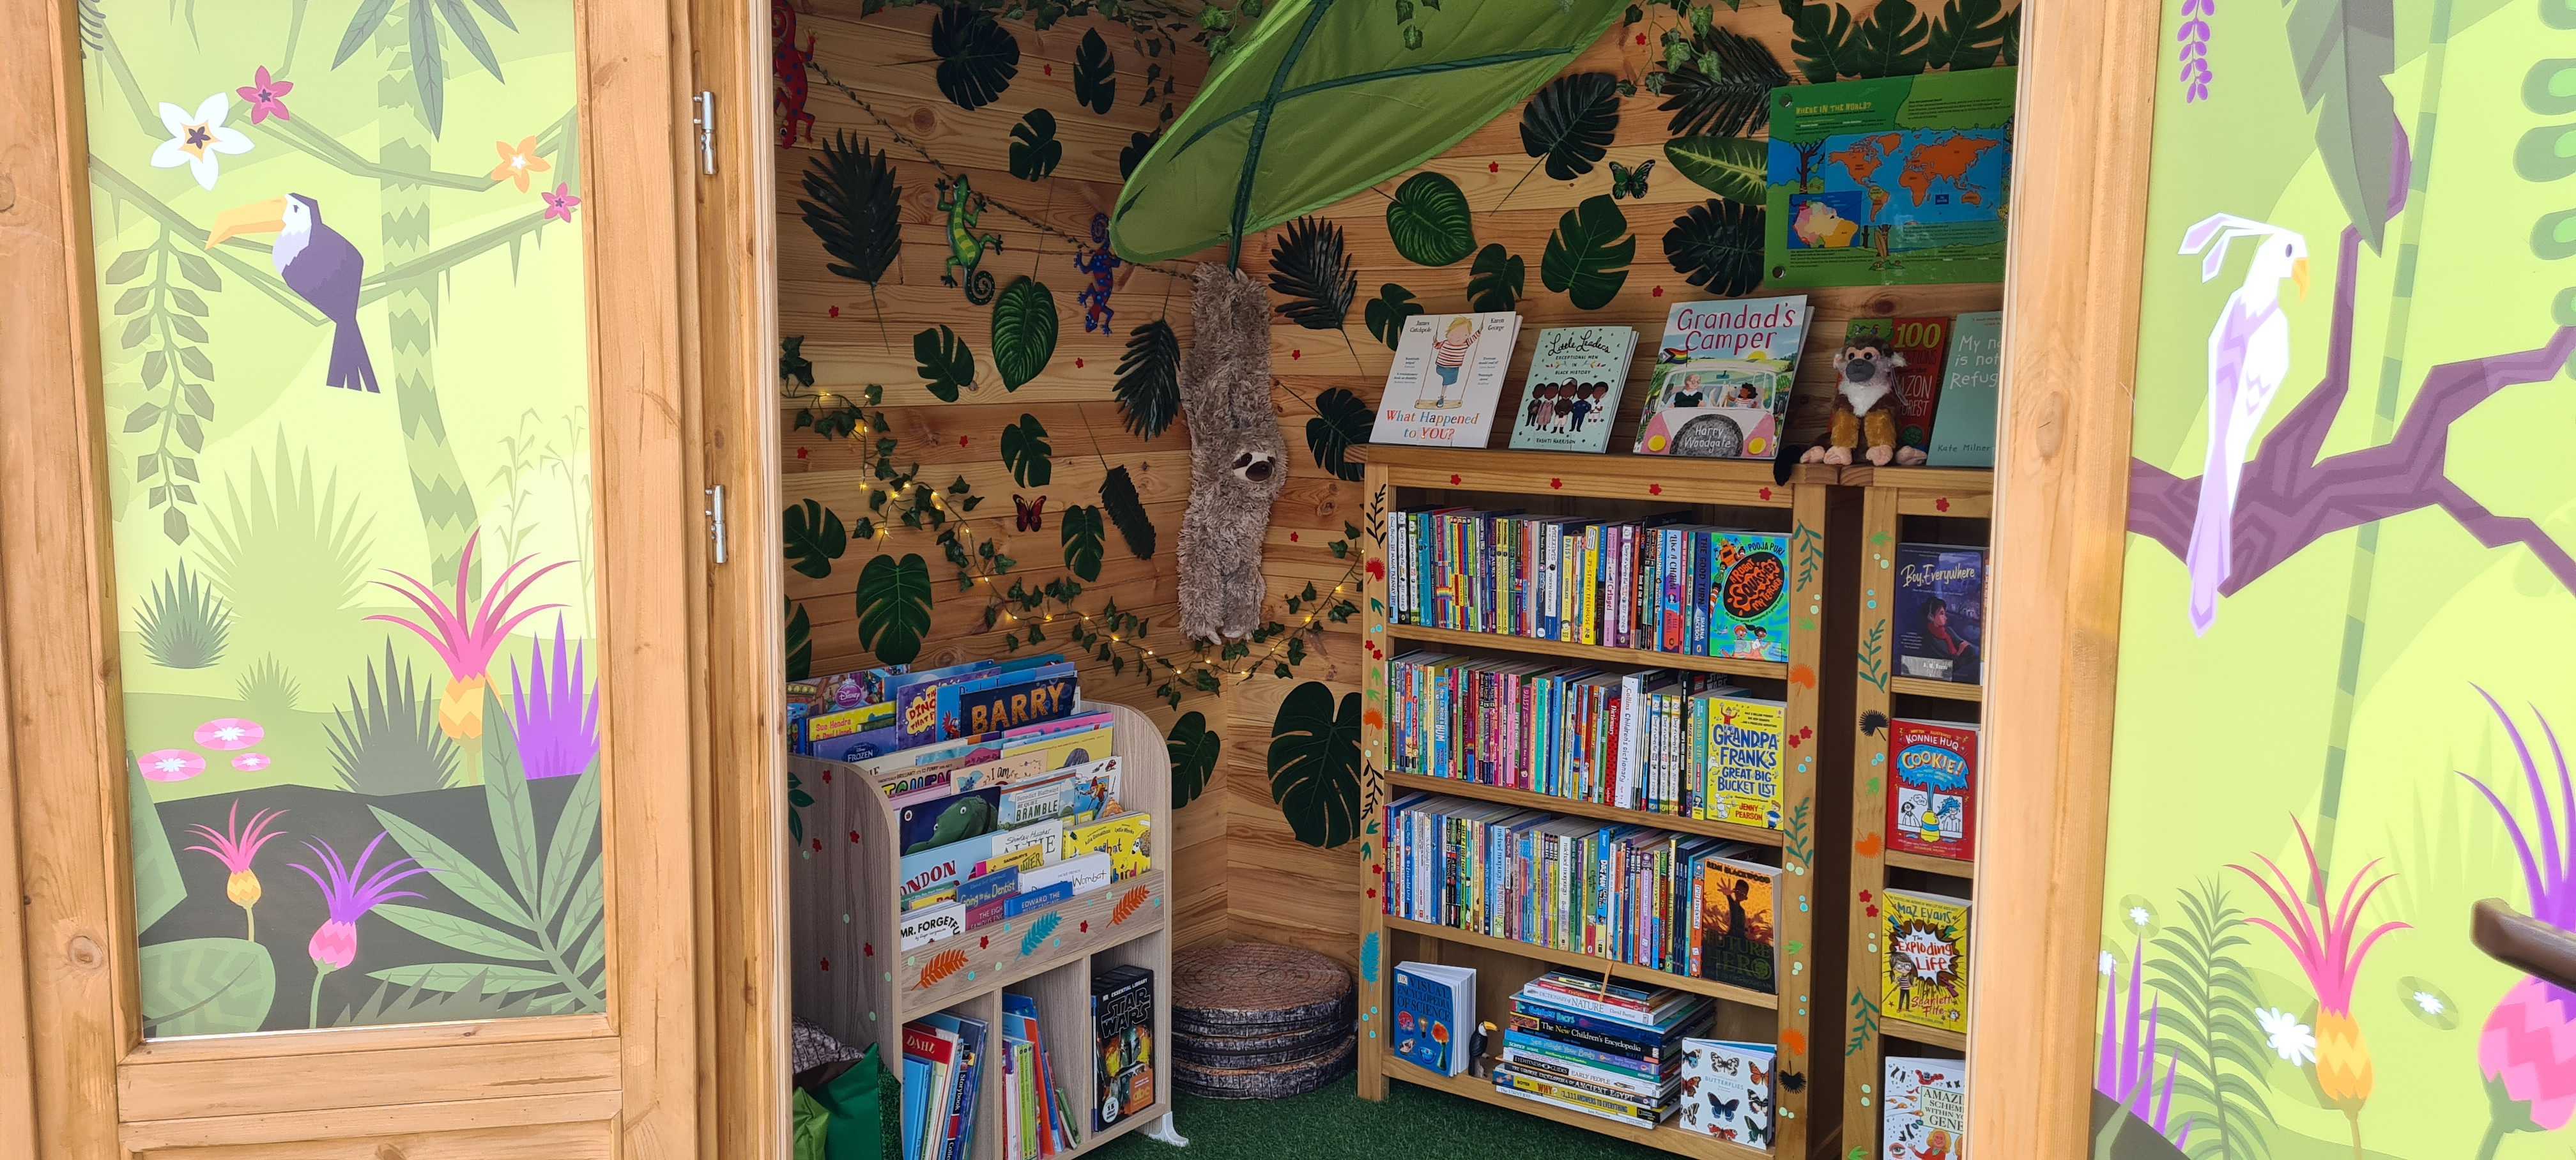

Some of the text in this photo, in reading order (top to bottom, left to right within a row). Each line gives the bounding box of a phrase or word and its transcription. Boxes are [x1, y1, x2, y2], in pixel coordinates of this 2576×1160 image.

[1796, 107, 1818, 115] WHERE
[1820, 105, 1828, 113] IN
[1846, 102, 1871, 111] WORLD?
[1677, 303, 1796, 331] Grandad's
[1548, 330, 1610, 356] Little Leaders
[1685, 330, 1777, 356] Camper
[1894, 323, 1941, 348] 100
[1959, 335, 1980, 351] My
[1955, 355, 1998, 366] is not
[1386, 409, 1480, 426] What Happened
[1404, 427, 1455, 440] to YOU?
[1695, 425, 1724, 438] Harry
[1684, 438, 1731, 453] Woodgate
[1937, 443, 1958, 452] Kate
[1748, 542, 1785, 556] POOJA PURI
[1733, 558, 1754, 583] ROBOT
[1922, 563, 1975, 586] Everywhere
[1733, 563, 1776, 606] SQUASHED
[1752, 578, 1783, 610] MY TEACHER
[839, 691, 860, 701] Disney
[971, 682, 1064, 735] BARRY
[829, 718, 851, 729] Hendra
[910, 716, 928, 729] THAT
[1608, 705, 1617, 736] Dictionary
[1713, 724, 1779, 751] GRANDPA
[1906, 735, 1959, 751] KONNIE HUQ
[847, 749, 873, 762] FROZEN
[1720, 747, 1777, 770] FRANK'S
[1902, 751, 1964, 777] COOKIE!
[991, 767, 1011, 780] I am
[1721, 767, 1772, 782] GREAT BIG
[1717, 776, 1777, 798] BUCKET LIST
[1016, 800, 1058, 821] BRAMBLE
[1739, 803, 1759, 812] JENNY
[1735, 811, 1763, 821] PEARSON
[1006, 832, 1029, 844] Shirley
[1093, 830, 1110, 839] Donaldson
[1004, 853, 1027, 863] SAINSBURY'S
[1599, 859, 1607, 873] DOG
[1072, 869, 1107, 887] Wombat
[1724, 867, 1770, 883] BLACKWOOD
[960, 895, 979, 907] Going
[992, 881, 1015, 897] Dentist
[1022, 897, 1048, 908] EDWARD
[1050, 892, 1060, 900] THE
[979, 910, 990, 920] THE
[1897, 902, 1917, 918] Maz
[1921, 908, 1952, 923] Evans
[901, 927, 916, 938] MR.
[1897, 940, 1953, 956] Exploding
[1916, 958, 1948, 971] Life
[1111, 978, 1148, 997] ESSENTIAL LIBRARY
[1409, 976, 1449, 999] VISUAL
[1101, 988, 1150, 1022] STAR
[1397, 996, 1450, 1022] OF SCIENCE
[1571, 996, 1604, 1014] NATURE
[1911, 995, 1952, 1009] Scarlett
[1101, 1000, 1150, 1039] WARS
[907, 1035, 935, 1054] DAHL
[1541, 1022, 1641, 1052] The New Children's Encyclopedia
[1514, 1056, 1542, 1067] EYEWITNESS
[1579, 1049, 1595, 1060] Body
[1571, 1070, 1611, 1084] EARLY PEOPLE
[1705, 1076, 1744, 1090] BUTTERFLIES
[954, 1073, 966, 1111] Storybook
[1538, 1083, 1578, 1100] WHY? 1,111
[1574, 1081, 1635, 1101] ANCIENT EGYPT
[1925, 1106, 1954, 1117] WITHIN
[1929, 1115, 1963, 1131] GENE
